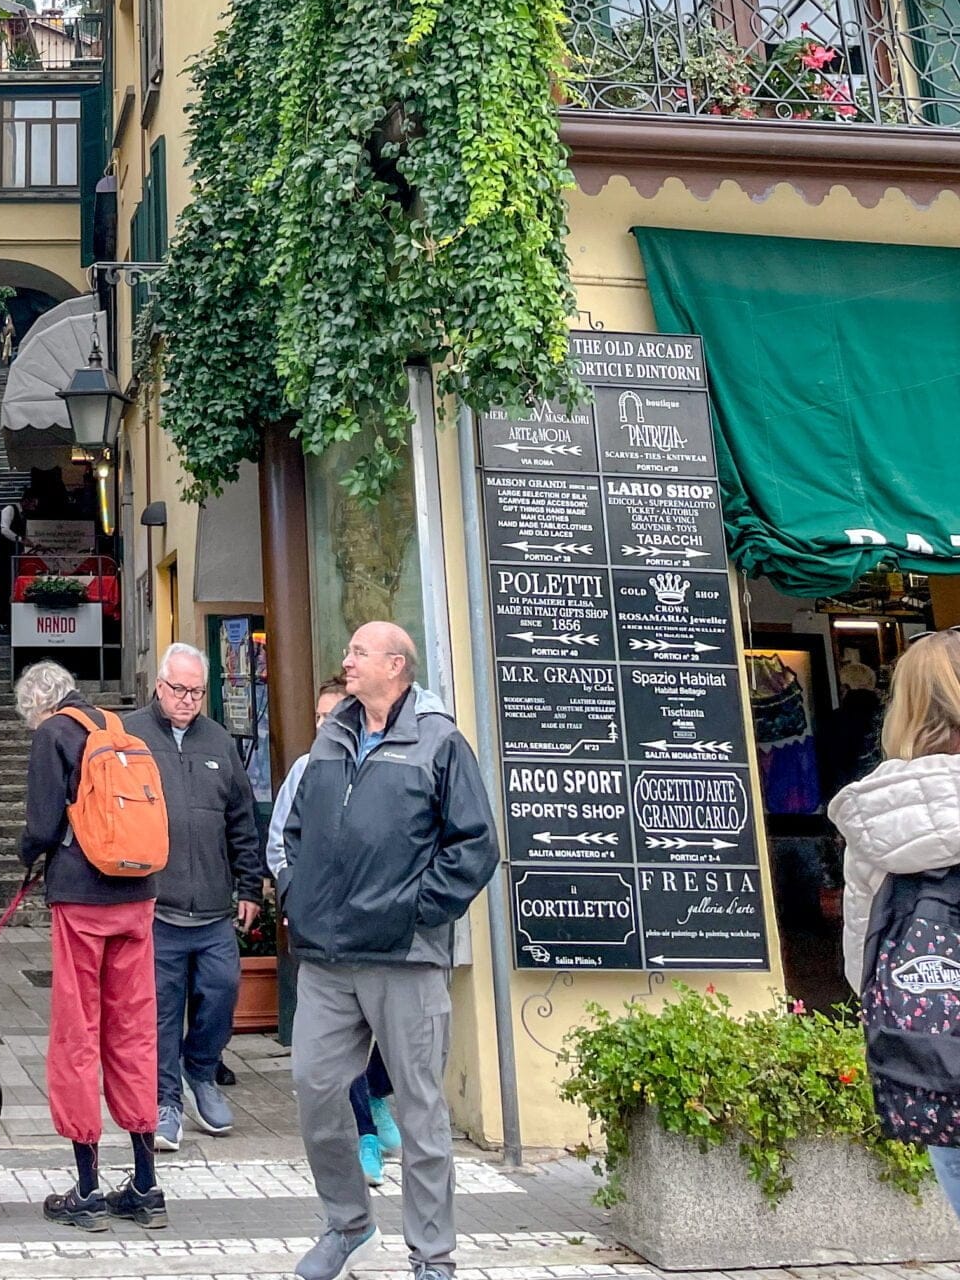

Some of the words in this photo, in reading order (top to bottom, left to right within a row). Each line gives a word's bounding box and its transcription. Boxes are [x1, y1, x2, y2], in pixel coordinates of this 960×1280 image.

[573, 339, 602, 355] THE
[605, 340, 633, 357] OLD
[637, 342, 694, 360] ARCADE
[571, 361, 622, 377] ORTICI
[625, 363, 633, 378] E
[636, 364, 701, 381] DINTORNI
[645, 399, 680, 409] boutique
[620, 424, 688, 452] PATRIZIA
[605, 451, 639, 459] SCARVES
[645, 452, 661, 460] TIES
[666, 453, 707, 462] KNITWEAR
[486, 477, 526, 487] MAISON
[528, 479, 567, 489] GRANDI
[522, 491, 560, 499] SELECTION
[607, 482, 662, 497] LARIO
[666, 484, 713, 499] SHOP
[498, 497, 530, 505] SCARVES
[608, 497, 643, 506] EDICOLA
[649, 499, 716, 509] SUPERENALOTTO
[626, 506, 655, 514] TICKET
[661, 508, 699, 517] AUTOBUS
[631, 514, 662, 523] GRATTA
[673, 516, 695, 524] VINCI
[540, 522, 593, 531] TABLECLOTHES
[676, 525, 697, 533] TOYS
[636, 534, 703, 546] TABACCHI
[498, 571, 603, 598] POLETTI
[620, 587, 647, 596] GOLD
[695, 591, 720, 599] SHOP
[509, 596, 520, 604] DI
[522, 597, 566, 606] PALMIERI
[568, 599, 594, 608] ELISA
[497, 605, 522, 615] MADE
[523, 606, 533, 615] IN
[534, 607, 558, 617] ITALY
[559, 608, 585, 618] GIFTS
[585, 609, 609, 619] SHOP
[654, 605, 690, 613] CROWN
[37, 616, 76, 634] NANDO
[551, 618, 581, 631] 1856
[618, 613, 688, 623] ROSAMARIA
[689, 615, 727, 625] jeweller
[532, 648, 560, 656] PORTICI
[653, 652, 682, 660] PORTICI
[501, 665, 539, 683] M.R.
[544, 667, 614, 685] GRANDI
[632, 670, 677, 687] Spazio
[679, 671, 727, 687] Habitat
[583, 684, 593, 693] by
[594, 684, 615, 692] Carla
[654, 686, 678, 694] Habitat
[679, 687, 706, 697] Bellagio
[556, 705, 584, 713] COSTUME
[529, 742, 572, 750] SERBELLONI
[645, 751, 670, 759] SALITA
[671, 752, 716, 760] MONASTERO
[509, 768, 558, 793] ARCO
[563, 769, 622, 794] SPORT
[640, 778, 693, 802] OGGETTI
[695, 780, 737, 803] D'ARTE
[510, 802, 578, 819] SPORT'S
[582, 804, 625, 819] SHOP
[642, 804, 694, 829] GRANDI
[695, 806, 739, 829] CARLO
[528, 849, 554, 857] SALITA
[555, 850, 600, 858] MONASTERO
[640, 871, 756, 893] FRESIA
[571, 885, 577, 894] il
[521, 899, 630, 918] CORTILETTO
[677, 896, 725, 925] galleria
[726, 896, 756, 915] d'arte
[555, 956, 574, 964] Salita
[914, 960, 943, 974] VANS
[920, 970, 942, 983] THE
